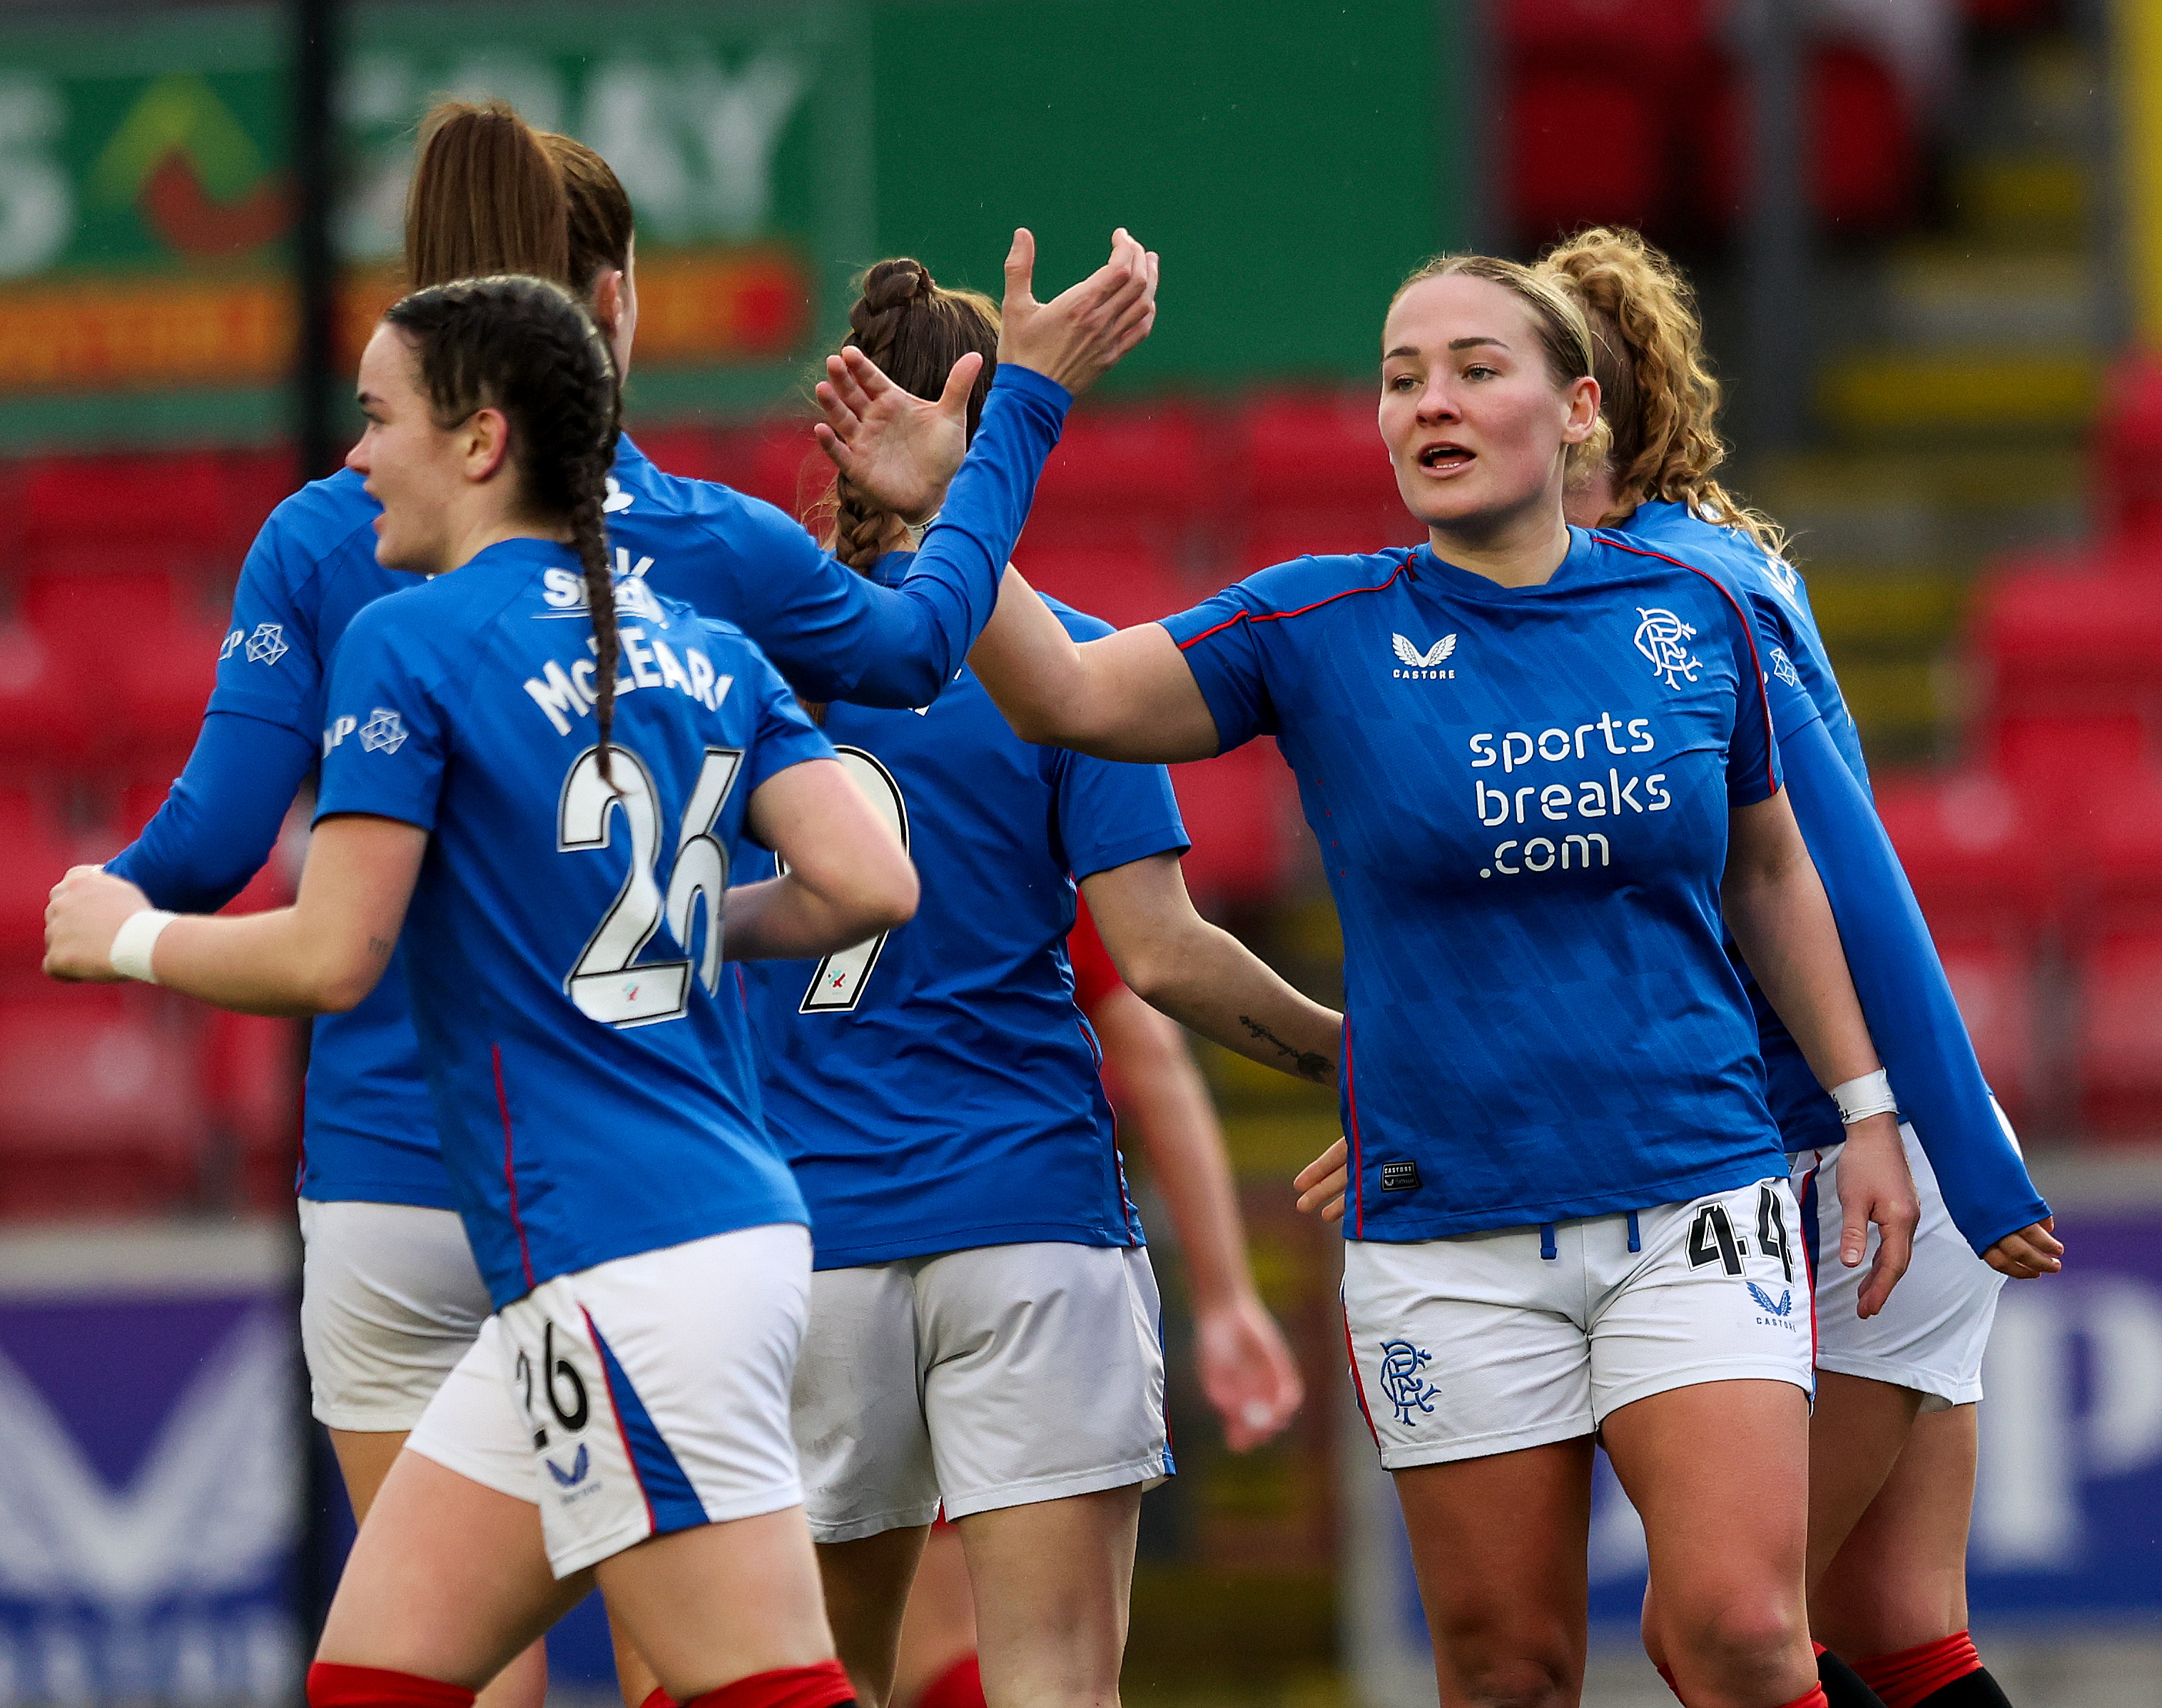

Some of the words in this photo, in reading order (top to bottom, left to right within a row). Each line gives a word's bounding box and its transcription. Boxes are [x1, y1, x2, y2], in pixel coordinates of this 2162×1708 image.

[1393, 669, 1456, 680] CASTORE
[1470, 711, 1655, 773] sports
[1476, 768, 1672, 827] breaks
[1479, 833, 1610, 879] .com
[557, 743, 746, 1030] 26
[1685, 1182, 1796, 1288] 44
